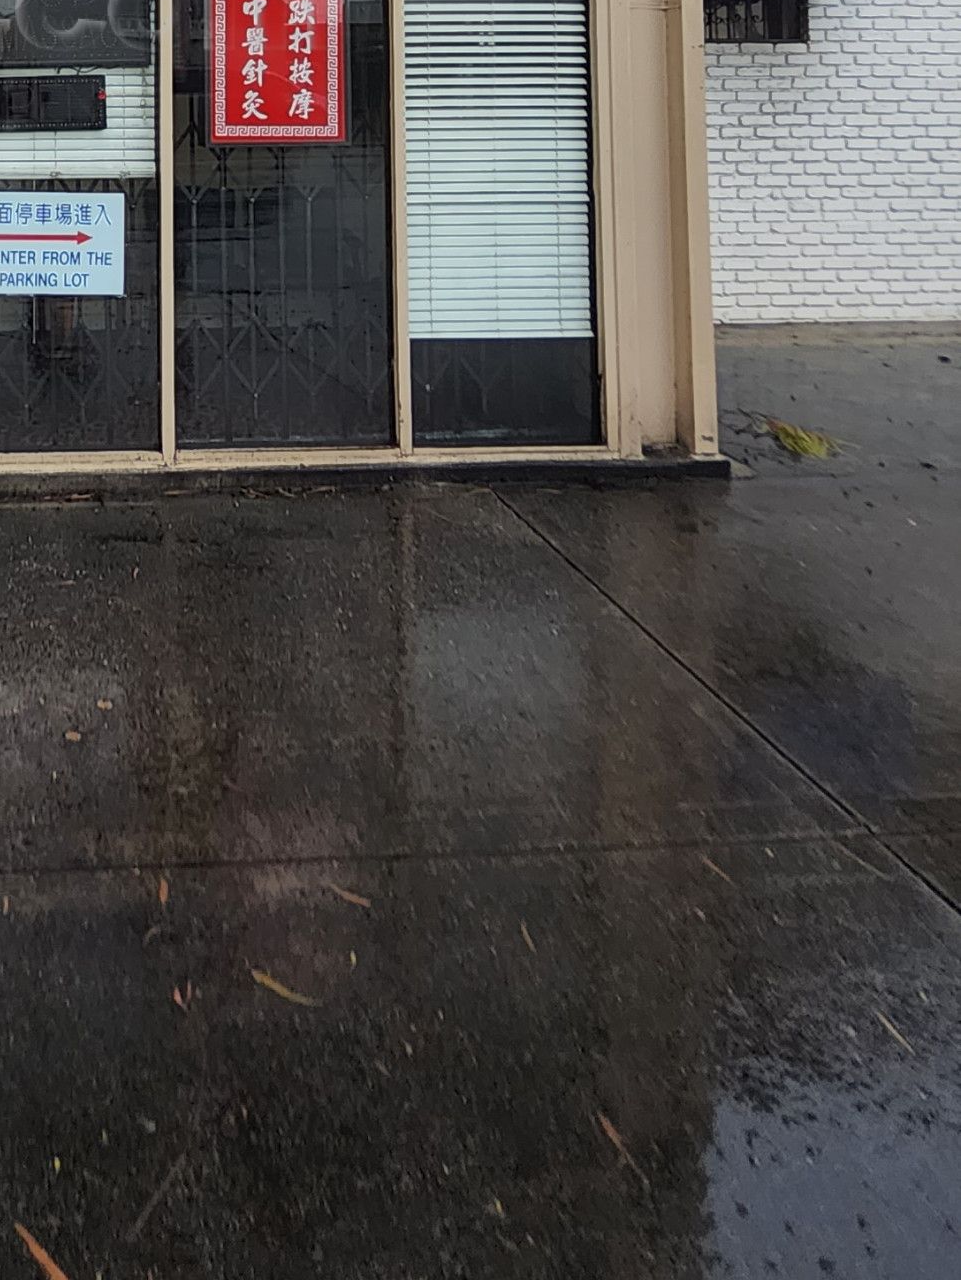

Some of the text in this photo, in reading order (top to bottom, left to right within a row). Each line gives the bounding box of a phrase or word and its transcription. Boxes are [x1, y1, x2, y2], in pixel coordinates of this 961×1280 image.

[42, 251, 81, 265] FROM
[87, 252, 113, 266] THE
[0, 272, 58, 287] PARKING
[64, 273, 90, 288] LOT
